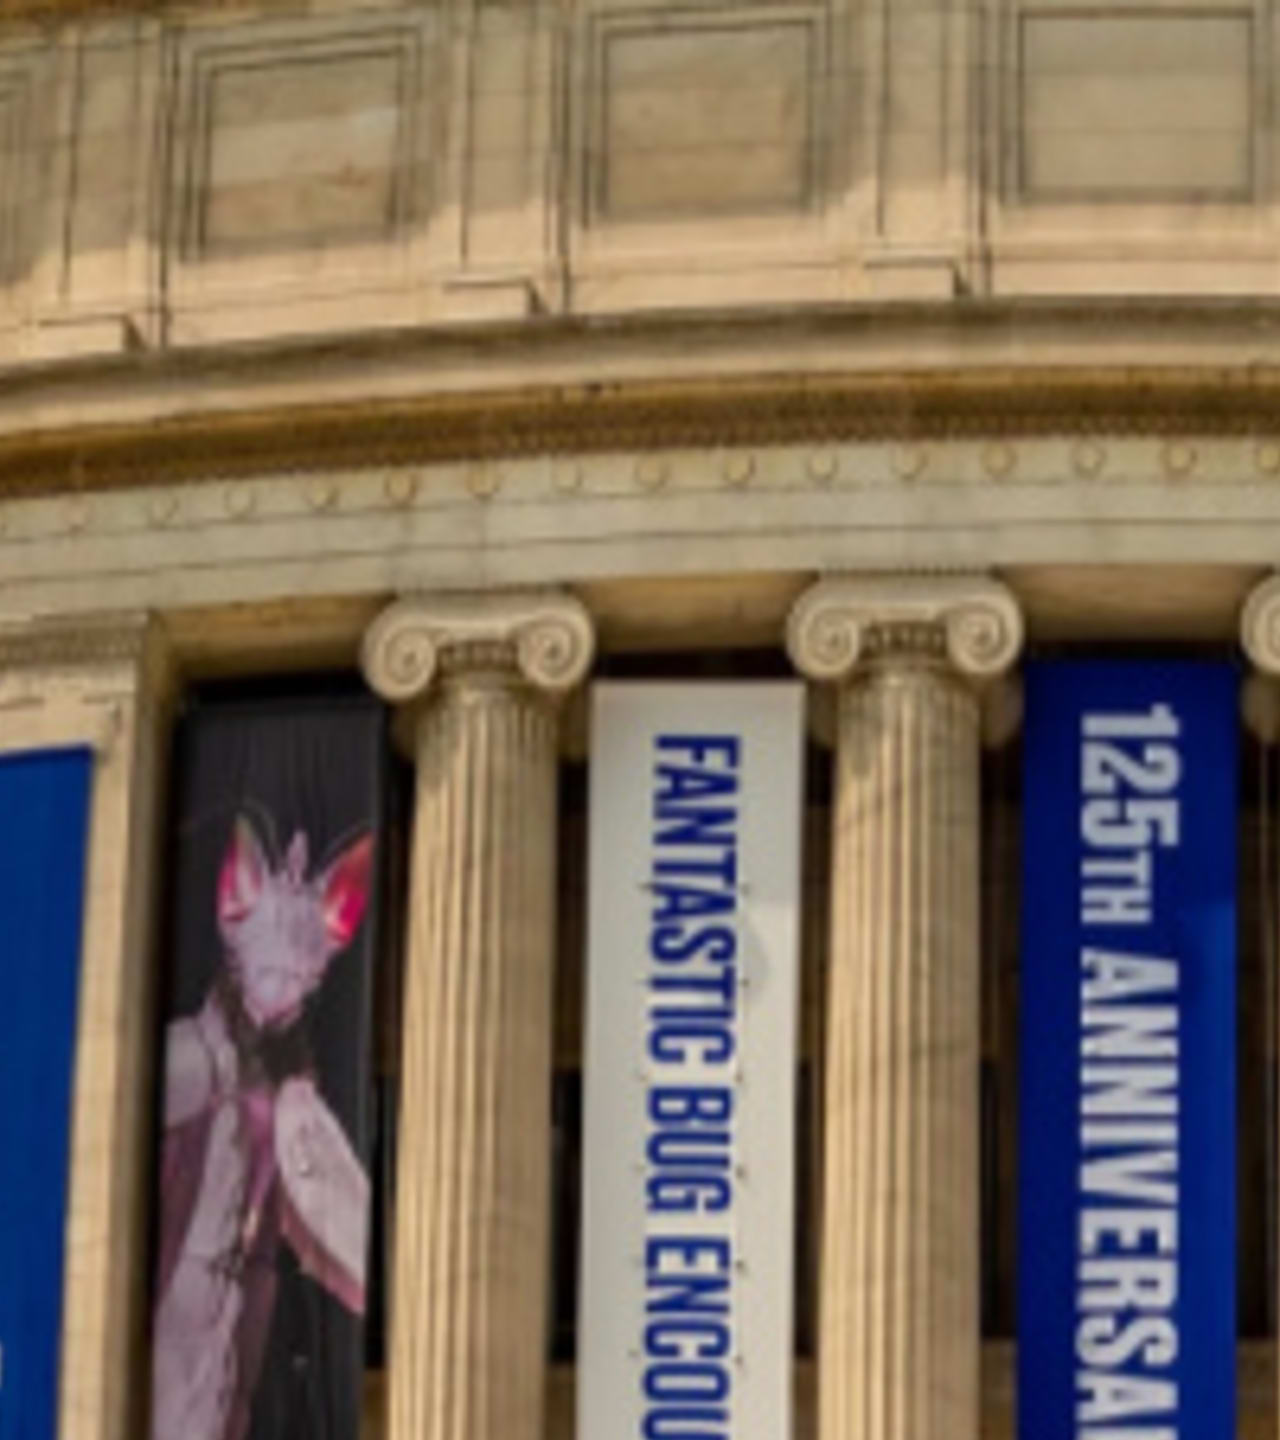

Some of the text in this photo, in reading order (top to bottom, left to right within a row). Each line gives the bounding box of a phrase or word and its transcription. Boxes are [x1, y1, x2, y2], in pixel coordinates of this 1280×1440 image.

[647, 734, 741, 1065] FANTASTIC
[1080, 703, 1181, 925] 125TH
[644, 1086, 733, 1215] BUG
